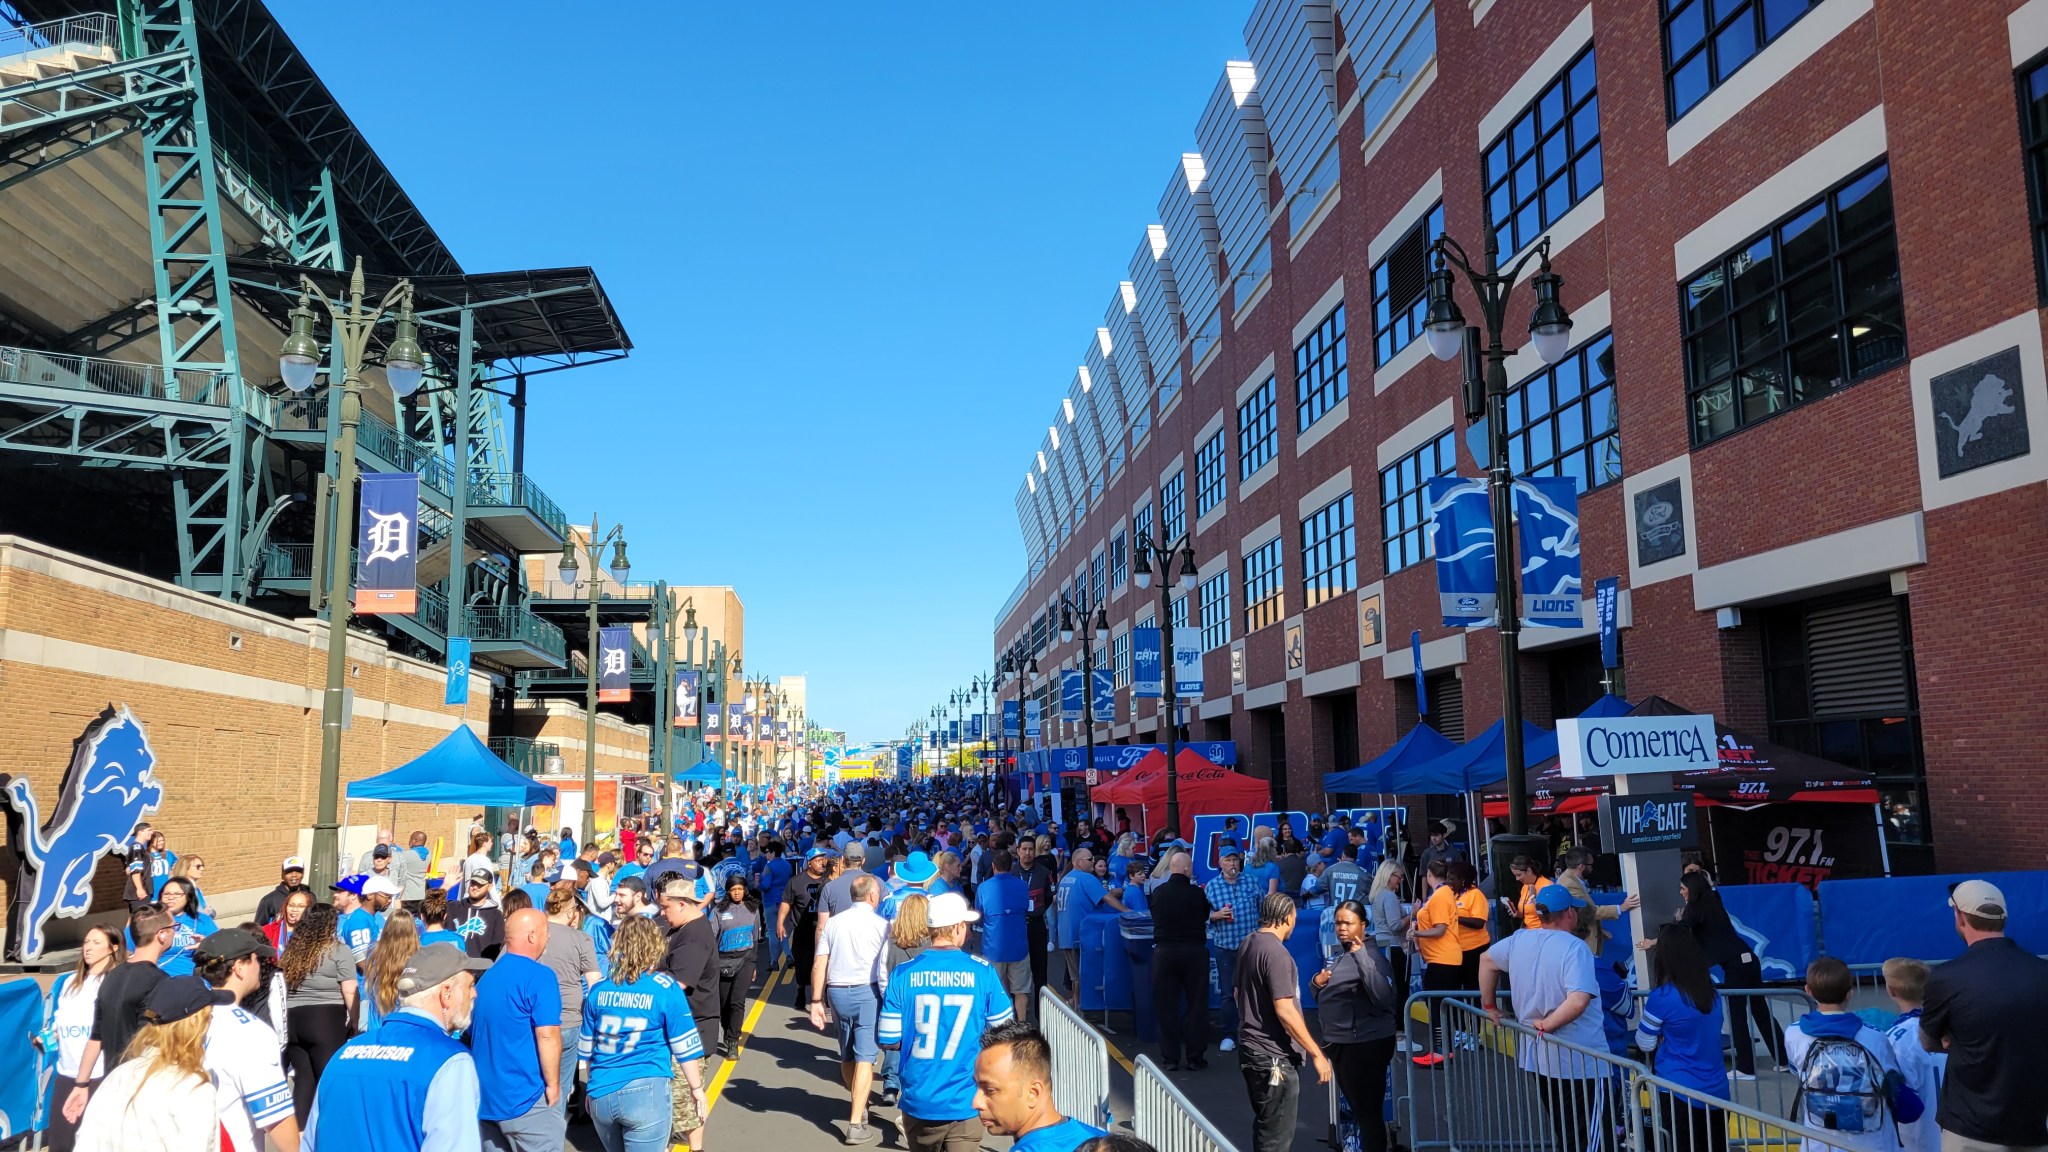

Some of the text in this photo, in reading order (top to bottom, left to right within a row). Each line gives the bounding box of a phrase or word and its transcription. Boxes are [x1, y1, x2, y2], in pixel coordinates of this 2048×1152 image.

[366, 509, 410, 567] D
[1532, 600, 1575, 612] LIONS
[1606, 587, 1615, 622] BEER
[604, 647, 626, 678] D
[1135, 651, 1159, 661] GRIT
[1176, 651, 1200, 661] GRIT
[1180, 683, 1200, 691] LIONS
[1095, 746, 1156, 768] BUILT Fo
[1738, 782, 1766, 794] 97.1
[1618, 802, 1687, 834] VIP GATE
[1763, 826, 1835, 866] 97.1 FM
[1332, 872, 1358, 880] HUTCHINSON
[1744, 861, 1831, 890] TICKET
[1334, 882, 1357, 904] 97
[351, 929, 370, 946] 20
[910, 970, 975, 988] HUTCHINSON
[597, 991, 654, 1010] HUTCHINSON
[61, 1025, 90, 1039] LION
[911, 993, 974, 1060] 97
[686, 1035, 700, 1048] LIO
[340, 1044, 415, 1061] SUPERVISOR
